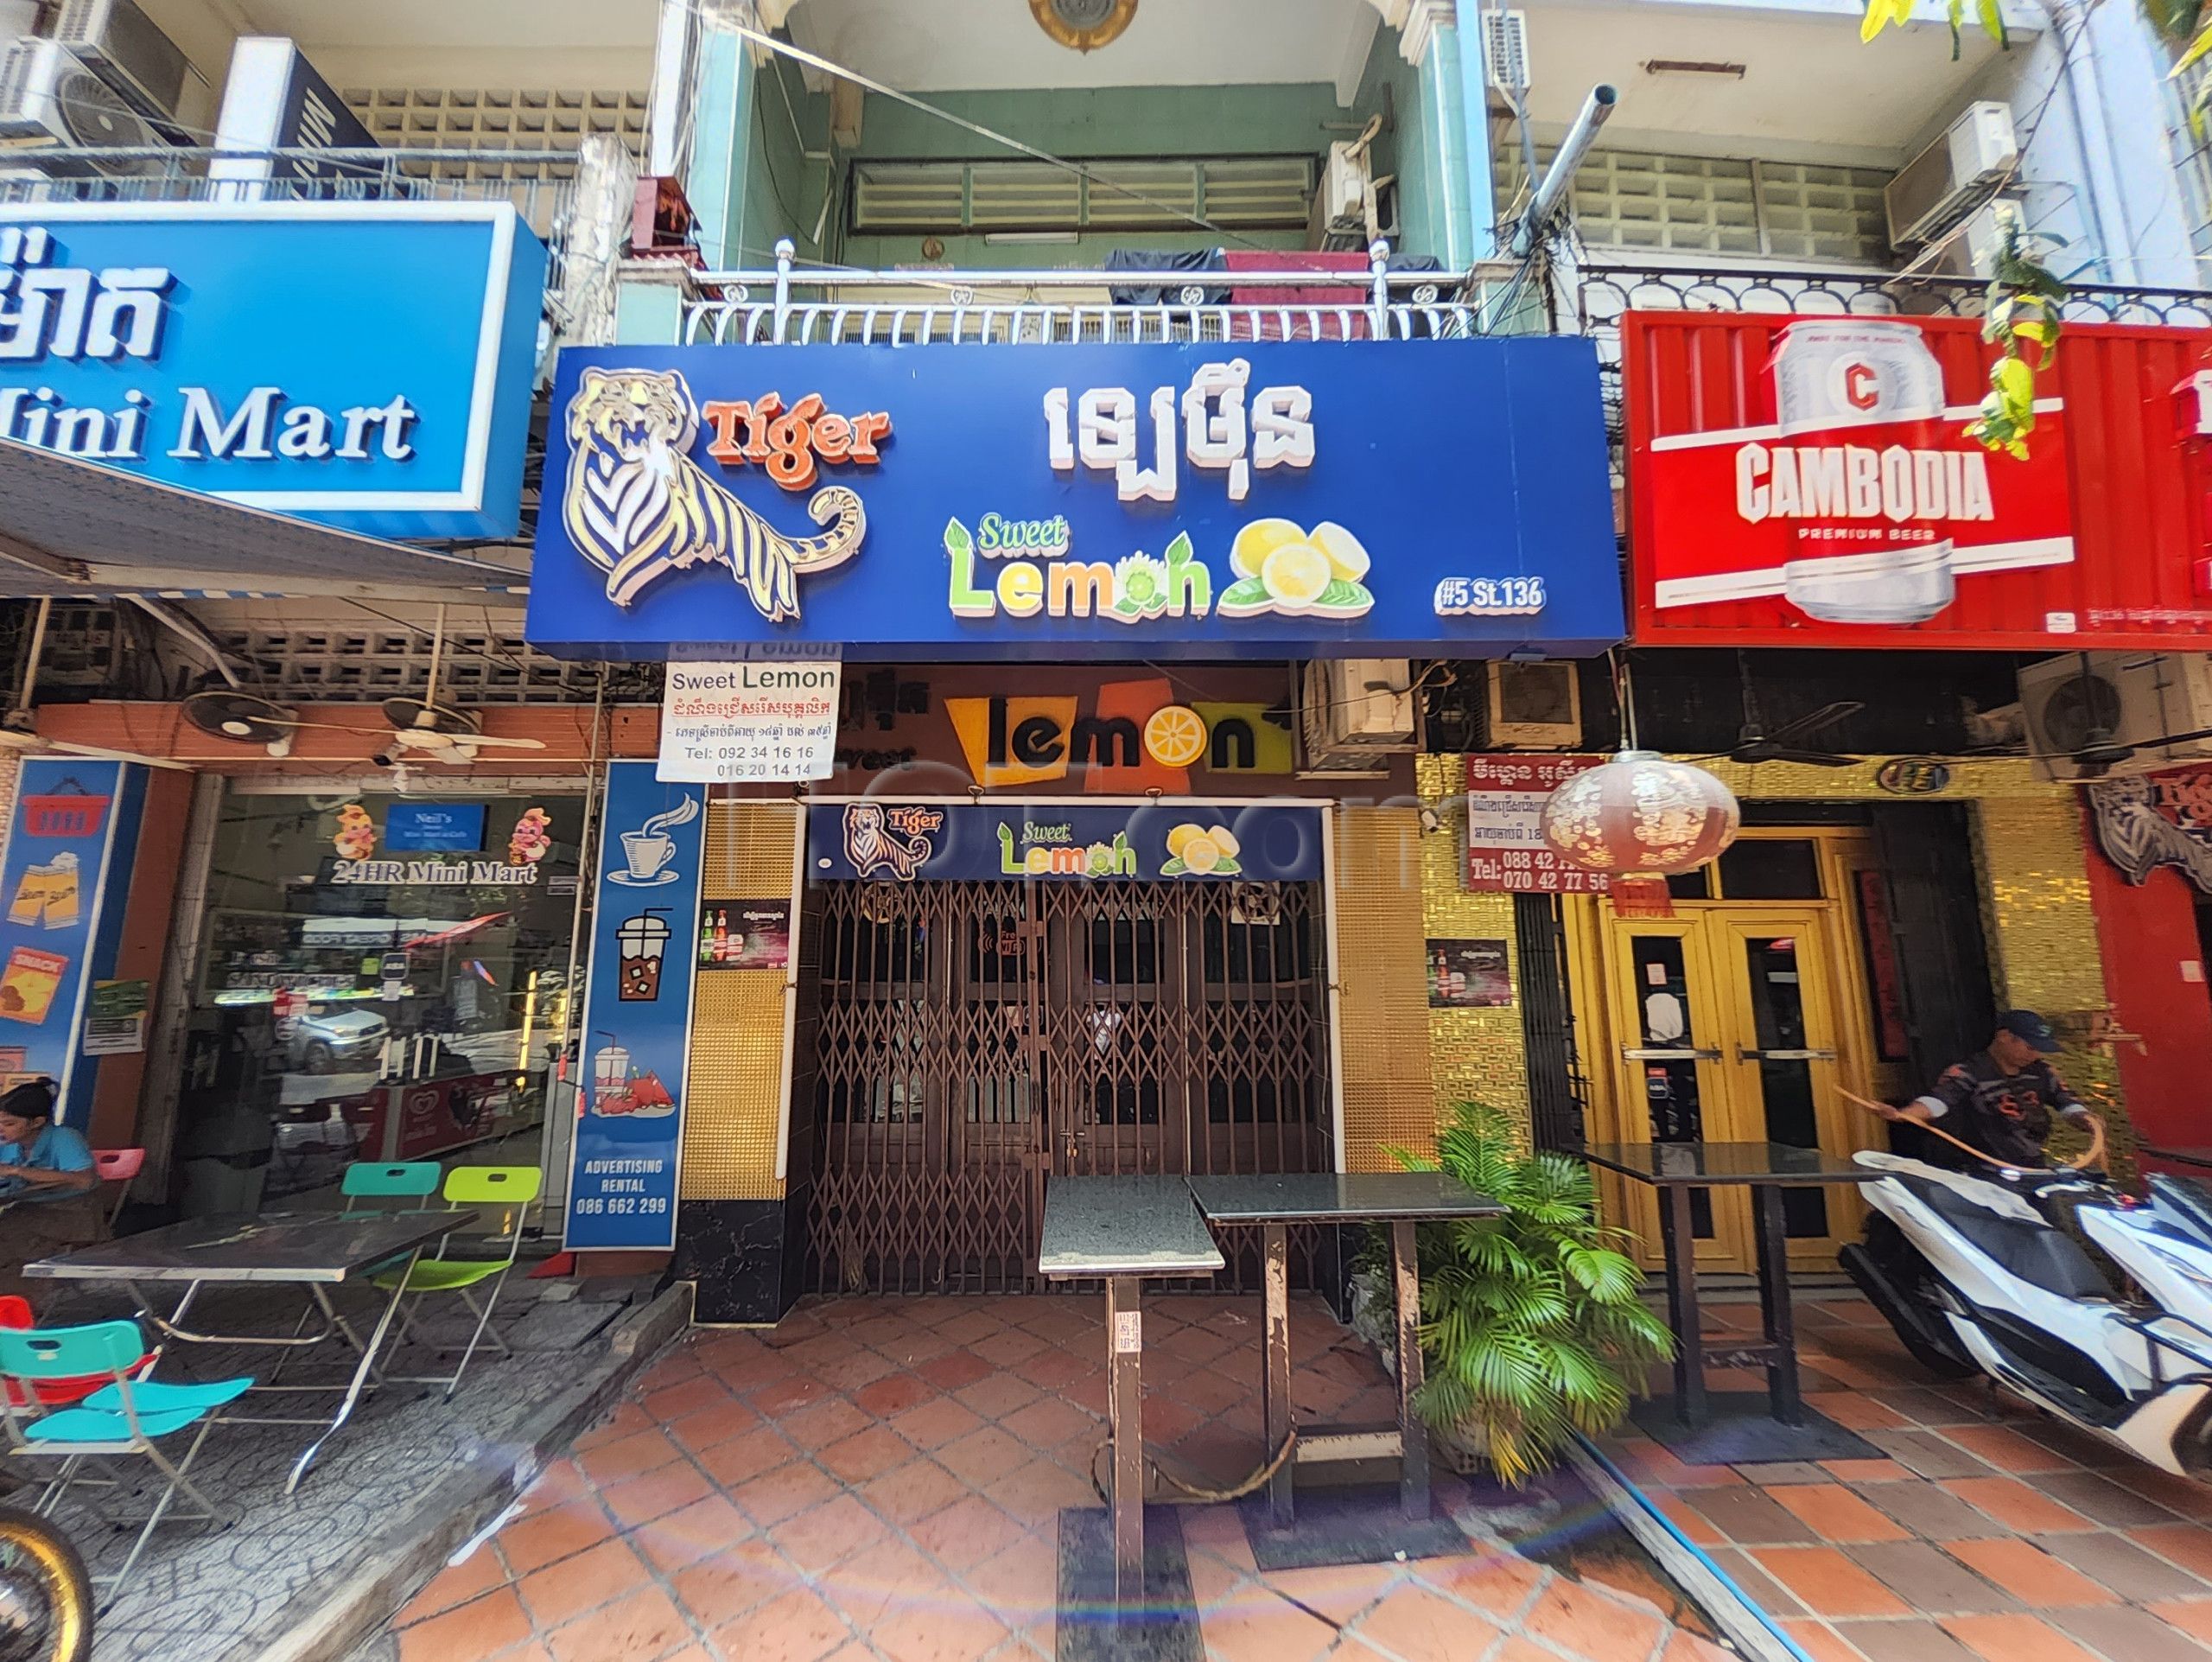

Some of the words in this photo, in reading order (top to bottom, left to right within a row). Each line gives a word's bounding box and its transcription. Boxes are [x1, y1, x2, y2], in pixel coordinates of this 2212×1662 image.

[167, 386, 417, 461] Mart
[702, 392, 894, 490] Tiger
[1736, 442, 1994, 525] CAMBODIA
[978, 512, 1069, 556] Sweet
[1798, 528, 1883, 541] PREMIUM
[1889, 528, 1936, 541] BEER
[944, 516, 1212, 622] Lemon
[1441, 580, 1469, 606] #5
[672, 672, 736, 691] Sweet
[742, 665, 835, 689] Lemon
[685, 747, 713, 760] Tel:
[718, 747, 746, 760] 092
[750, 747, 768, 759] 34
[773, 747, 791, 759] 16
[798, 747, 814, 758] 16
[717, 765, 744, 777] 016
[749, 765, 766, 776] 20
[772, 764, 790, 776] 14
[795, 764, 811, 775] 14
[887, 807, 944, 836] Tiger
[1023, 821, 1071, 842] Sweet
[997, 822, 1136, 877] Lemon
[331, 861, 405, 884] 24HR
[405, 860, 467, 884] Mini
[470, 861, 538, 885] Mart
[1471, 858, 1502, 880] Tel:
[1503, 851, 1531, 869] 088
[1535, 851, 1554, 869] 42
[1503, 871, 1533, 889] 070
[1538, 871, 1558, 889] 42
[1563, 872, 1583, 890] 77
[1588, 873, 1609, 890] 56
[584, 1159, 663, 1175] ADVERTISING
[601, 1178, 646, 1193] RENTAL
[576, 1199, 603, 1215] 086
[607, 1199, 634, 1214] 662
[639, 1198, 666, 1214] 299
